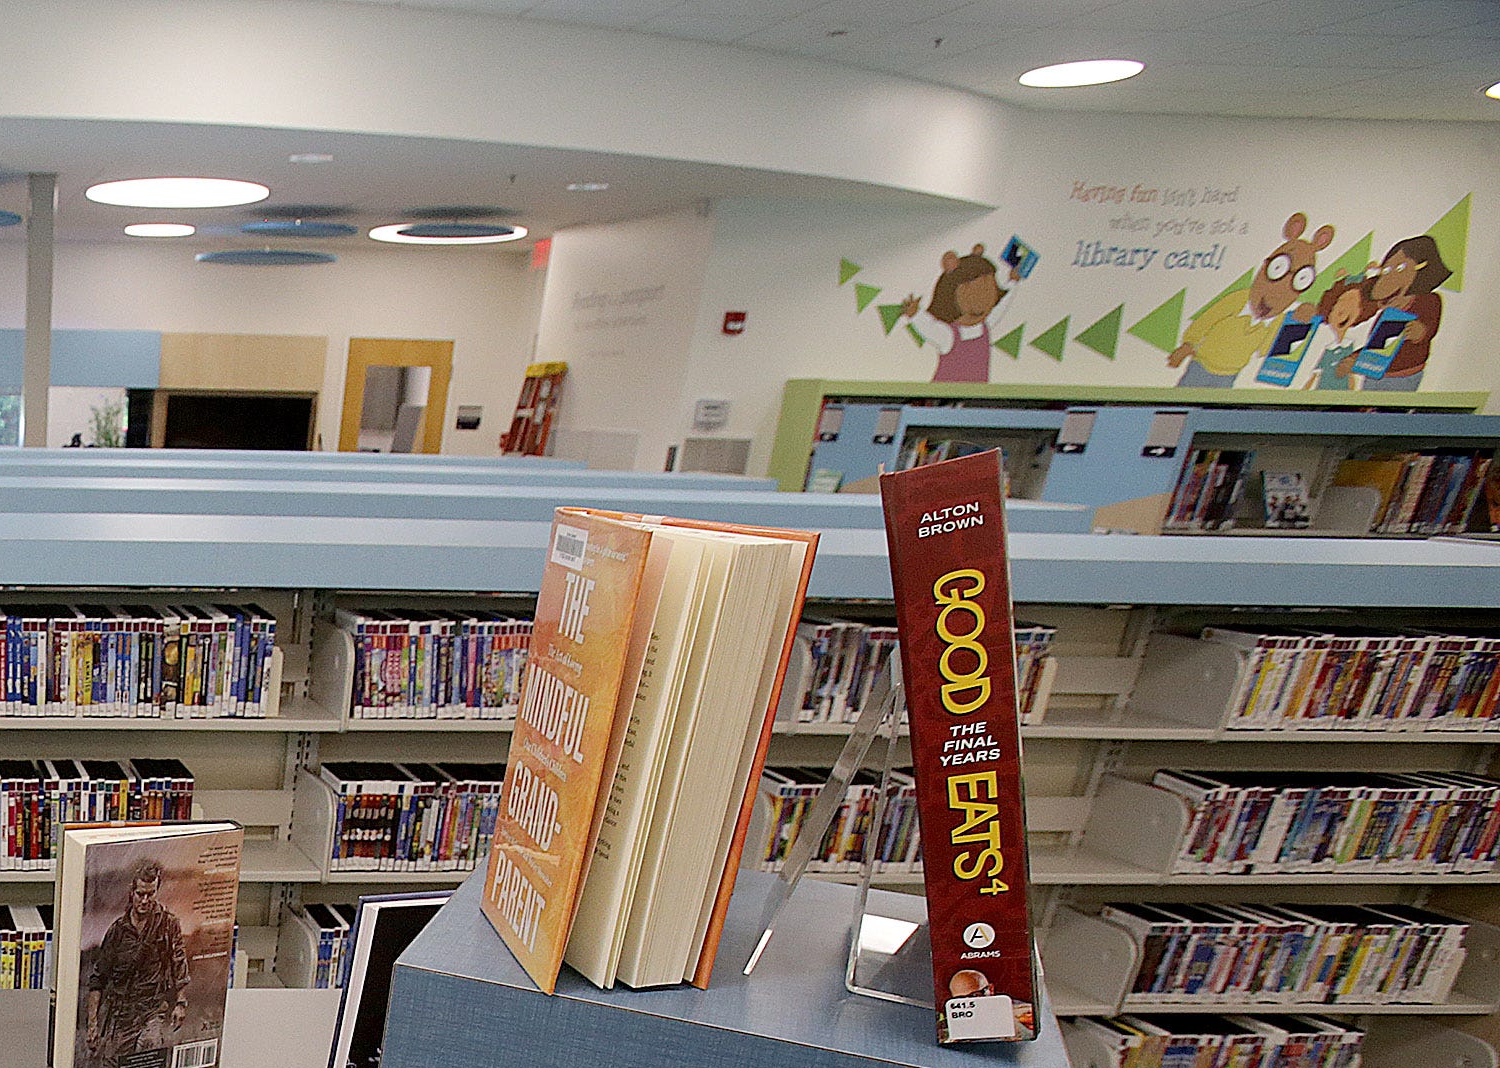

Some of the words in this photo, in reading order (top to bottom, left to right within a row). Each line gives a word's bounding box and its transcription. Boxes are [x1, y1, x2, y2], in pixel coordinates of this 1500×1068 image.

[1130, 183, 1159, 203] fun
[1238, 222, 1249, 235] a
[1071, 239, 1159, 271] library
[1163, 242, 1227, 271] card!
[920, 501, 980, 523] ALTON
[918, 514, 984, 538] BROWN
[557, 572, 595, 645] THE
[933, 568, 991, 714] GOOD
[521, 662, 590, 764] MINDFUL
[949, 721, 987, 737] THE
[943, 735, 998, 752] FINAL
[940, 748, 1001, 767] YEARS
[507, 760, 562, 852] GRAND-
[948, 770, 1004, 880] EATS
[979, 878, 1010, 896] 4
[491, 849, 546, 954] PARENT
[960, 950, 1001, 960] ABRAMS
[951, 1010, 974, 1019] BRO
